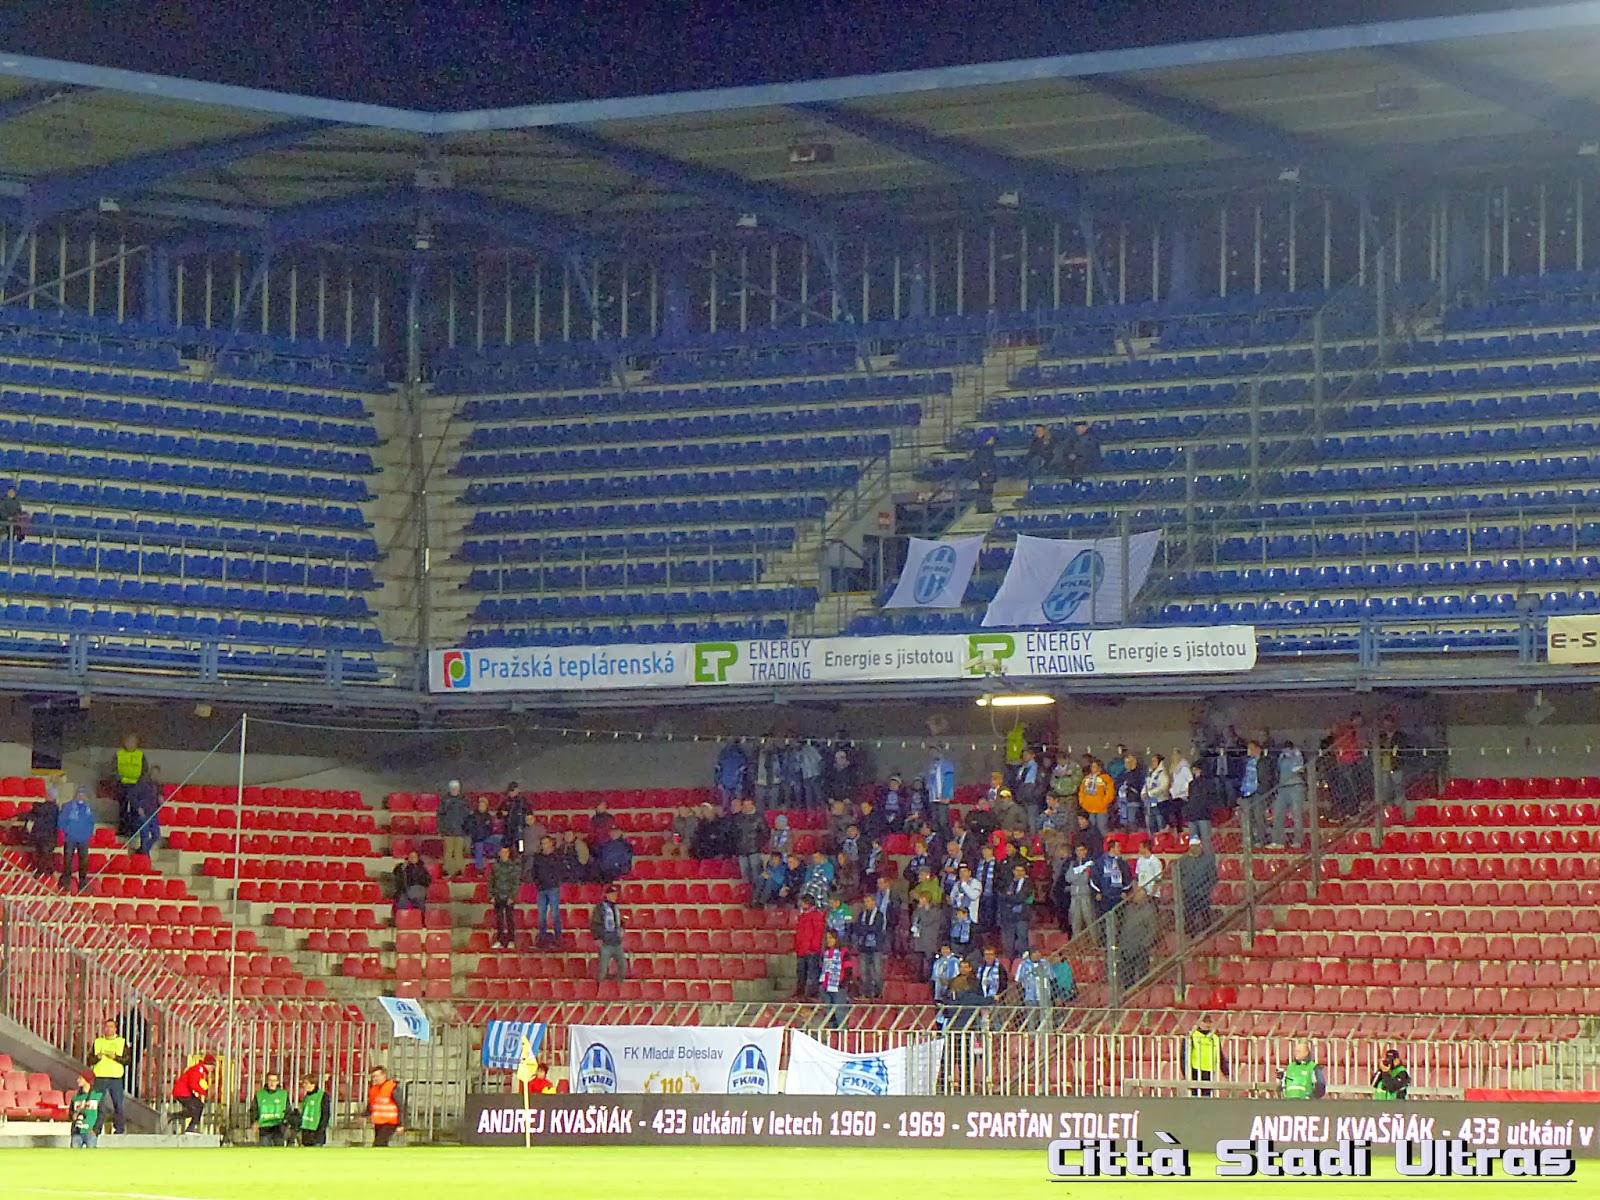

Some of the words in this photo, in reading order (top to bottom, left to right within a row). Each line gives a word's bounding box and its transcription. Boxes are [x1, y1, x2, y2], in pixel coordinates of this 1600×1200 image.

[750, 640, 811, 660] ENERGY
[1027, 632, 1092, 651] ENERGY
[1108, 642, 1168, 662] Energie
[1173, 647, 1182, 658] s
[1186, 641, 1247, 662] jistotou
[479, 652, 553, 679] Pražská
[559, 650, 675, 681] teplárenská
[694, 642, 738, 682] EP
[825, 650, 881, 670] Energie
[885, 654, 893, 665] s
[896, 648, 954, 669] jistotou
[1028, 654, 1095, 674] TRADING
[750, 662, 811, 681] TRADING
[624, 1047, 639, 1059] FK
[642, 1046, 675, 1060] Mladá
[678, 1046, 724, 1060] Boleslav
[582, 1076, 614, 1088] FKMB
[660, 1077, 684, 1093] 110
[732, 1077, 765, 1088] FKMB
[478, 1109, 545, 1134] ANDREJ
[551, 1105, 633, 1134] KVAŠŇÁK
[652, 1109, 687, 1134] 433
[692, 1110, 748, 1135] utkání
[752, 1116, 764, 1135] v
[768, 1111, 823, 1136] letech
[830, 1111, 876, 1136] 1960
[898, 1112, 946, 1137] 1969
[966, 1109, 1051, 1138] SPARŤAN
[1059, 1110, 1140, 1139] STOLETÍ
[1250, 1115, 1329, 1142] ANDREJ
[1336, 1114, 1435, 1143] KVAŠŇÁK
[1458, 1117, 1500, 1145] 433
[1507, 1119, 1574, 1146] utkání
[1579, 1126, 1594, 1146] v
